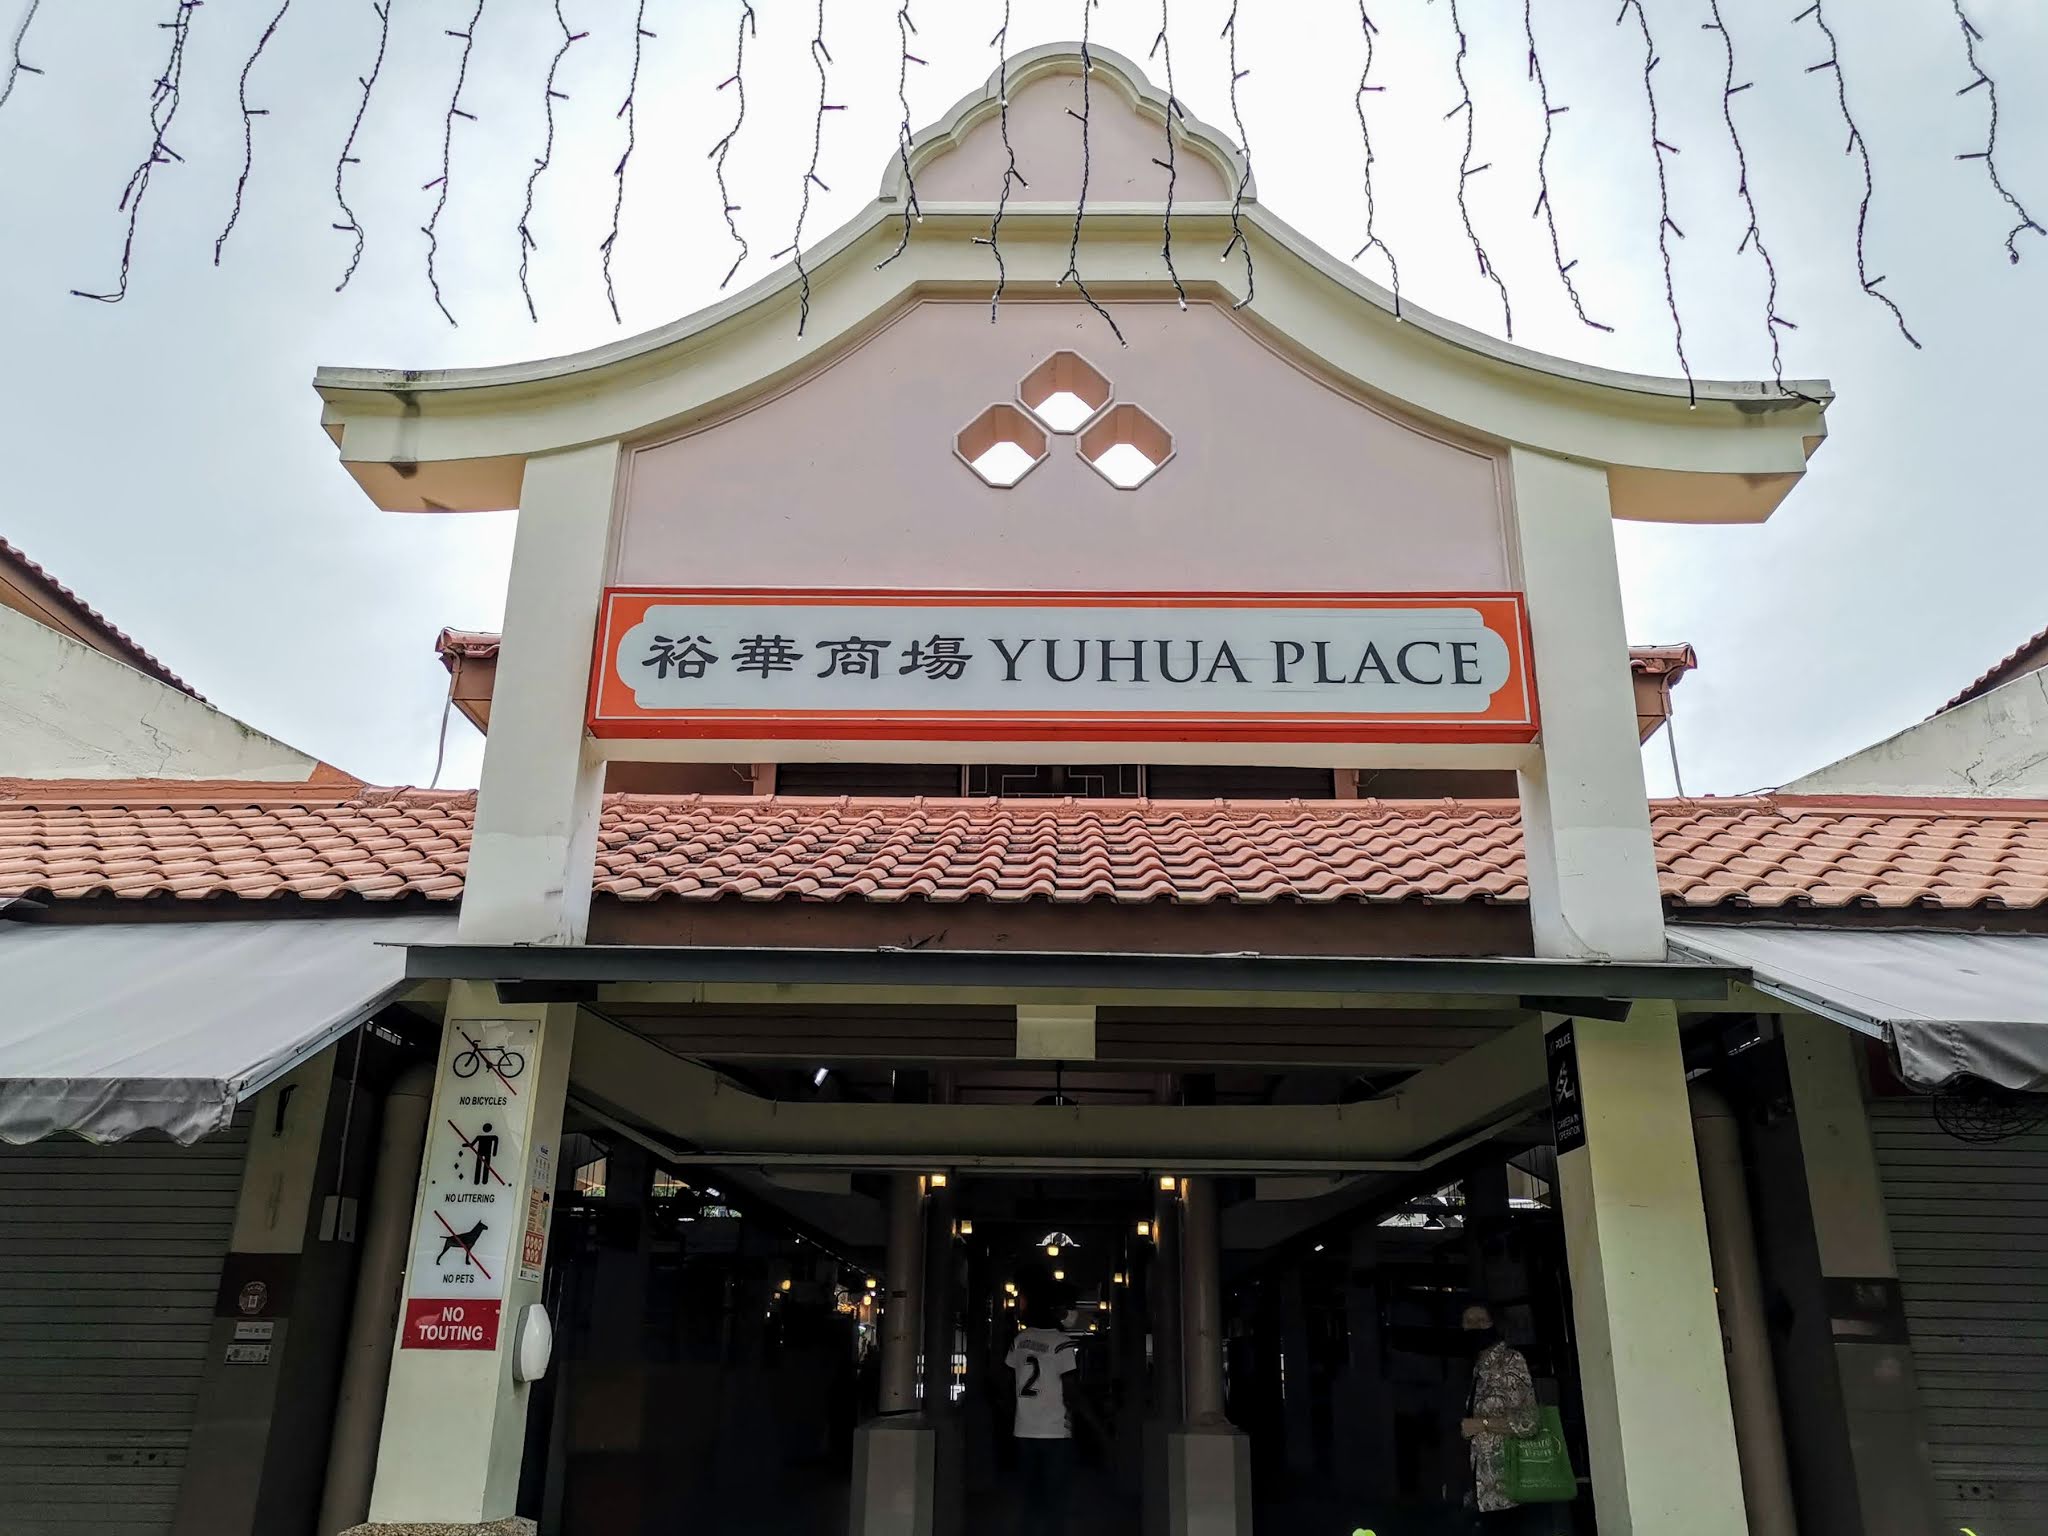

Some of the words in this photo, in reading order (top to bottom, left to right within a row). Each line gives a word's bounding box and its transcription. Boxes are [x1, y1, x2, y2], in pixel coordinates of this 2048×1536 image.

[988, 639, 1253, 684] YUHUA
[1270, 640, 1483, 685] PLACE
[1555, 1032, 1571, 1050] POLICE
[459, 1096, 471, 1106] NO
[471, 1096, 507, 1106] BICYCLES
[445, 1193, 457, 1203] NO
[457, 1193, 496, 1203] LITTERING
[442, 1273, 454, 1284] NO
[455, 1273, 475, 1284] PETS
[441, 1306, 465, 1322] NO
[418, 1325, 484, 1341] TOUTING
[1020, 1355, 1040, 1397] 2
